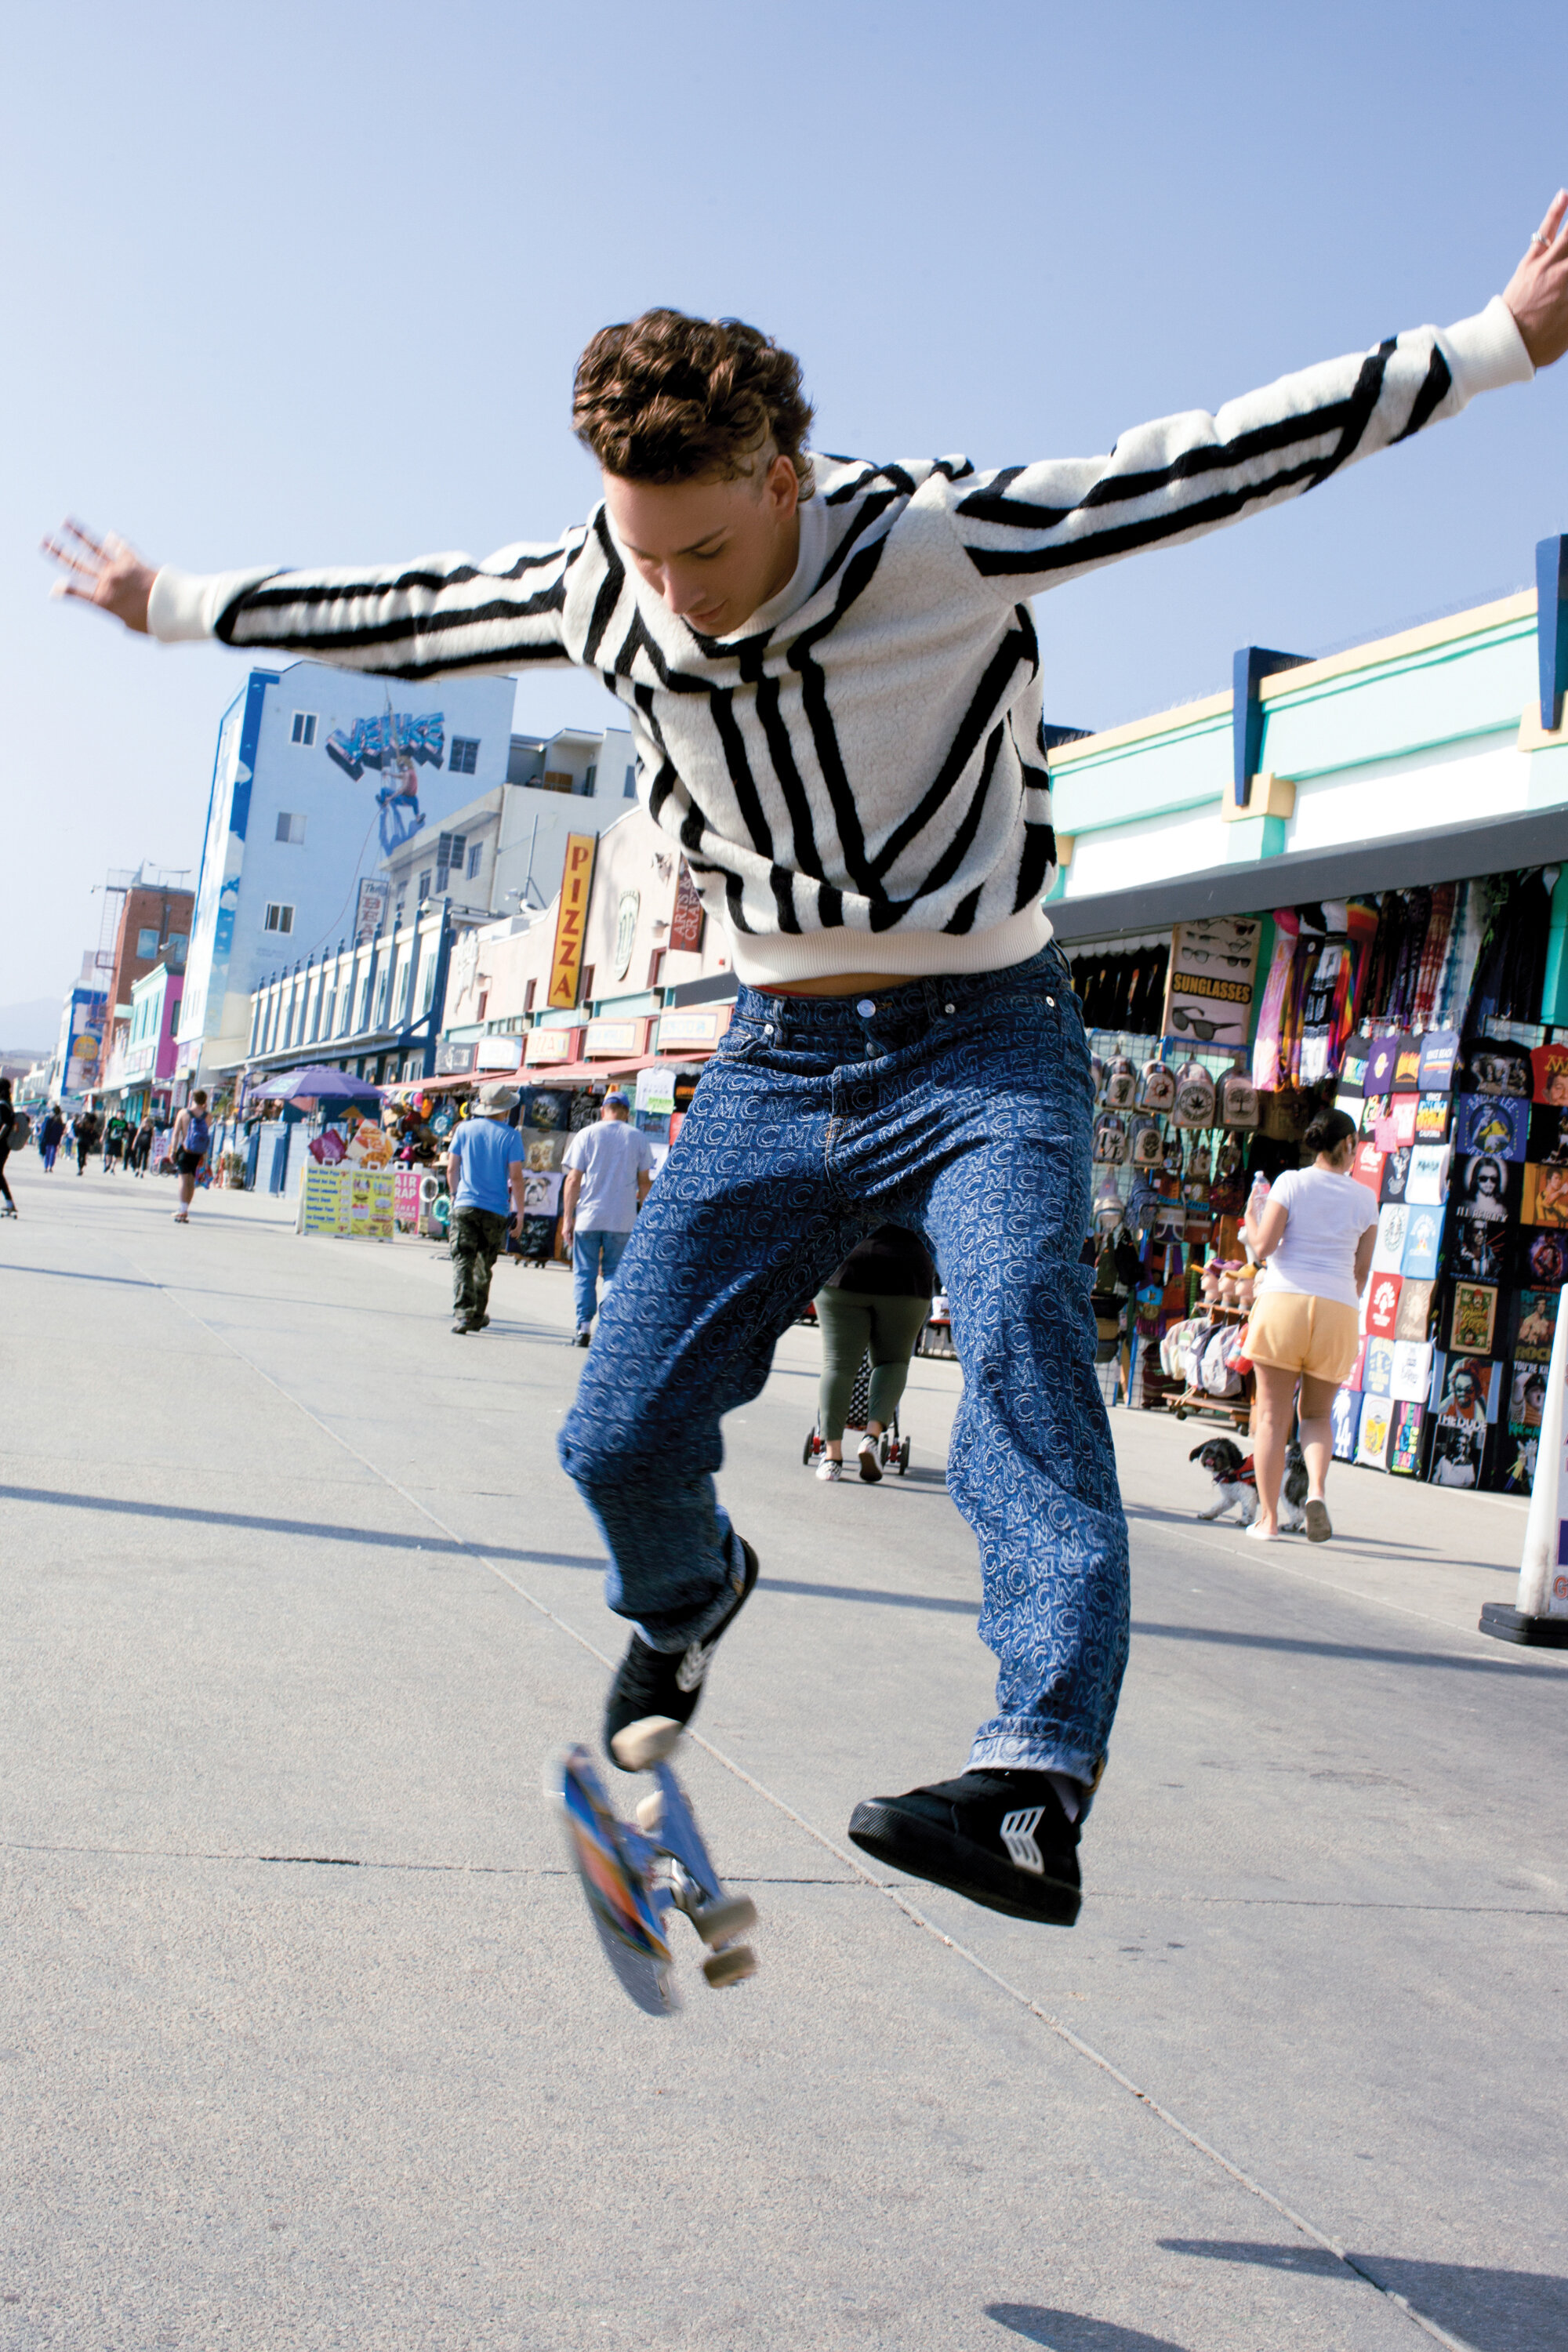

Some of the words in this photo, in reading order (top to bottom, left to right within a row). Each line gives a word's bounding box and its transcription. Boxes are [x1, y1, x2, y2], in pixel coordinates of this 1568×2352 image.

[679, 876, 691, 889] &
[554, 846, 588, 998] PIZZA
[673, 892, 689, 937] ARTS
[684, 888, 701, 941] CRAF
[1174, 974, 1250, 1003] SUNGLASSES
[1500, 1095, 1518, 1113] LEE
[394, 1174, 417, 1188] AIR
[394, 1186, 417, 1200] RAP
[1515, 1346, 1551, 1362] ROC
[1437, 1413, 1457, 1426] THE
[1457, 1414, 1487, 1432] DUDE
